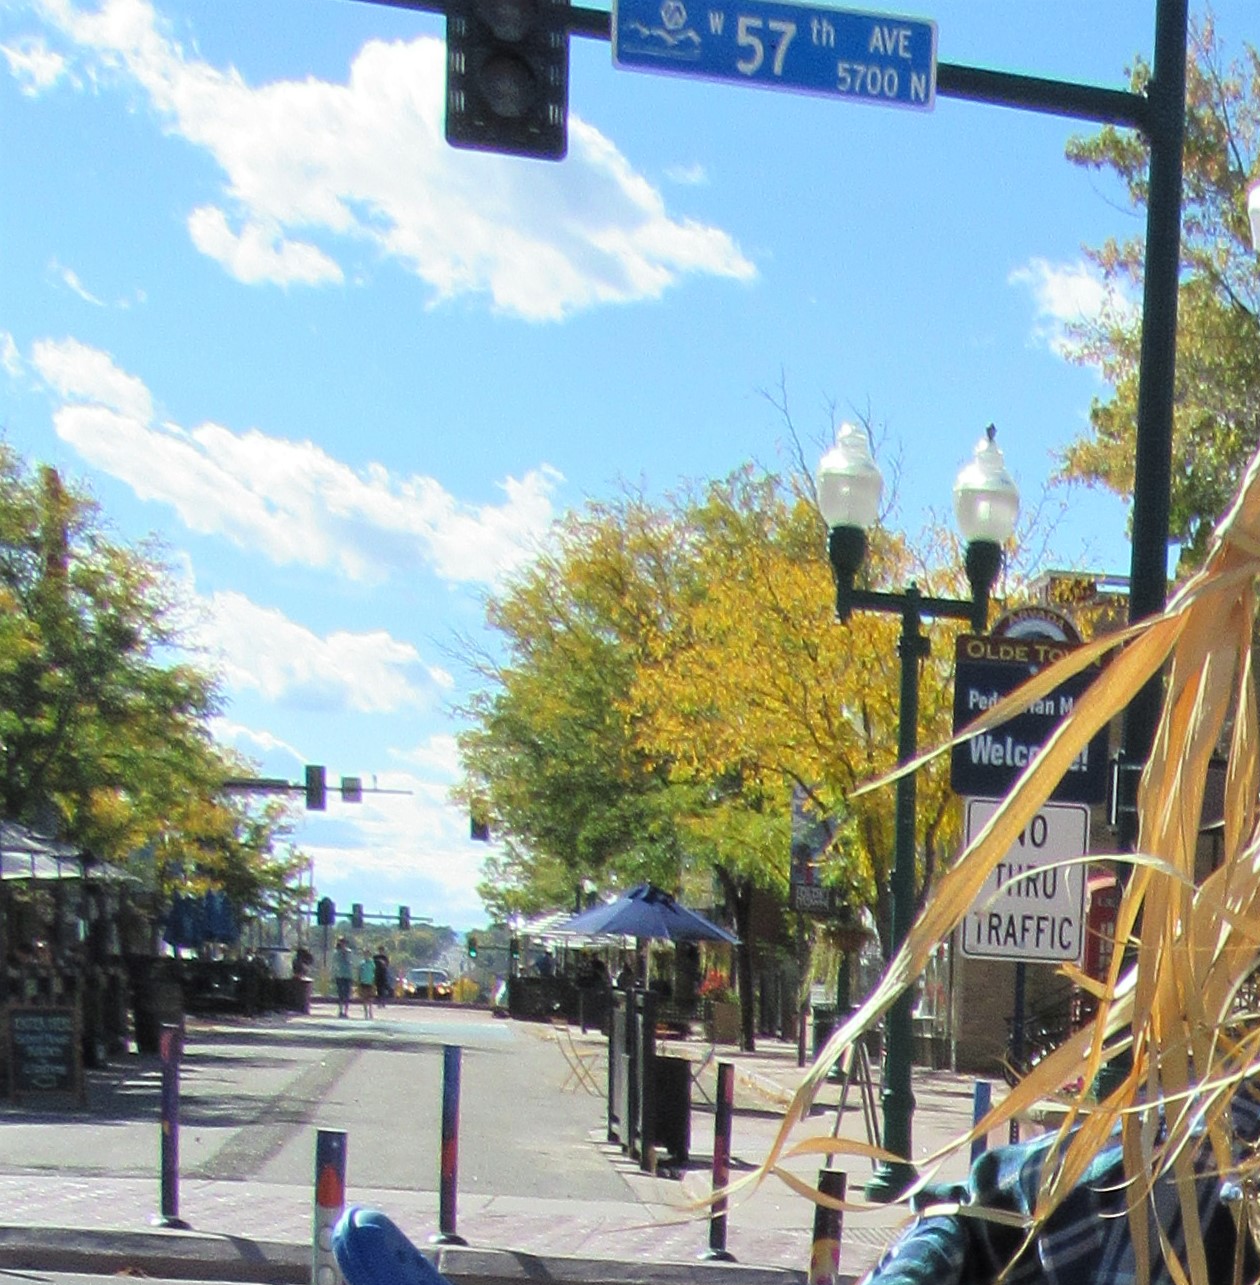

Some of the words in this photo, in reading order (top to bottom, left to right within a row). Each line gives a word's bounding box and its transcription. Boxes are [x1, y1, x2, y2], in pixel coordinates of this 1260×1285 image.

[709, 11, 725, 35] W
[869, 25, 912, 59] AVE
[836, 62, 899, 97] 5700
[910, 72, 926, 102] N
[966, 640, 1029, 662] OLDE
[968, 689, 1055, 716] Pedian
[970, 735, 1089, 772] Welc!
[997, 863, 1058, 899] THRU
[974, 912, 1073, 950] TRAFFIC
